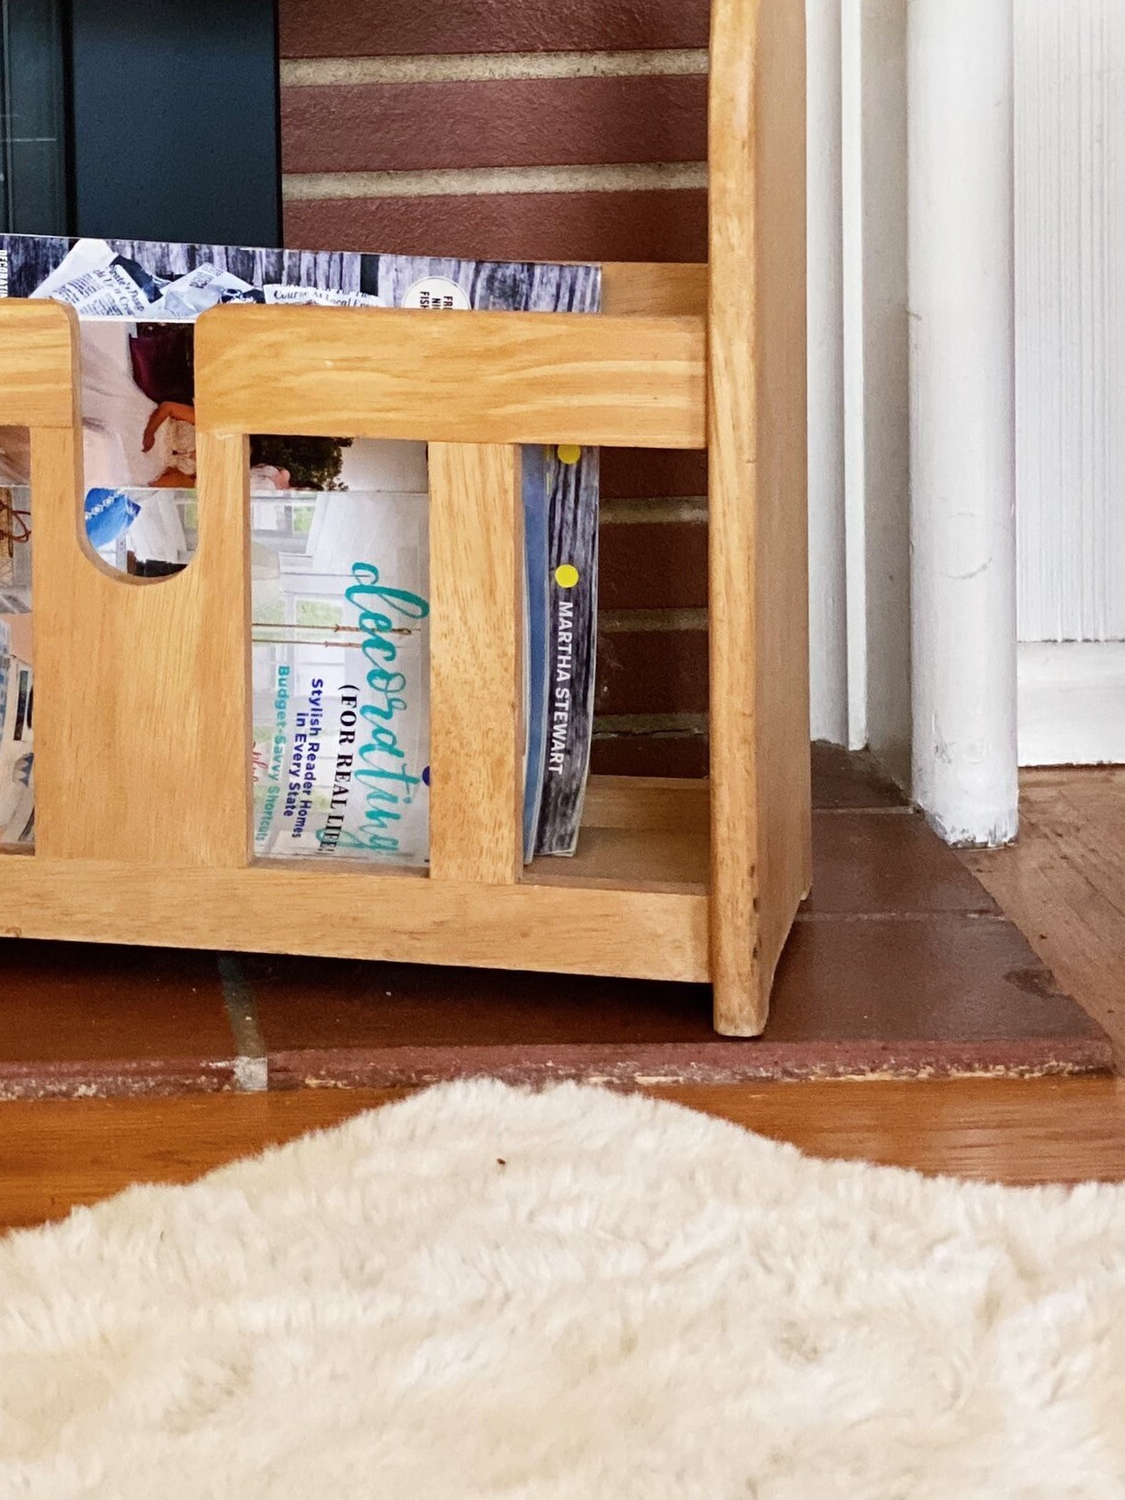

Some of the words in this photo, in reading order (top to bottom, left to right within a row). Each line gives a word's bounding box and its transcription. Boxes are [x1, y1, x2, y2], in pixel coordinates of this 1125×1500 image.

[556, 601, 574, 682] MARTHA
[267, 665, 291, 781] Budget-Savvy
[296, 712, 310, 728] in
[308, 677, 324, 737] Stylish
[315, 562, 430, 850] decorating
[337, 684, 361, 746] (FOR
[548, 687, 571, 776] STEWART
[288, 733, 307, 778] Every
[302, 742, 320, 796] Reader
[330, 753, 354, 810] REAL
[255, 784, 281, 843] Shortcuts
[283, 782, 301, 817] State
[291, 799, 313, 839] Homes
